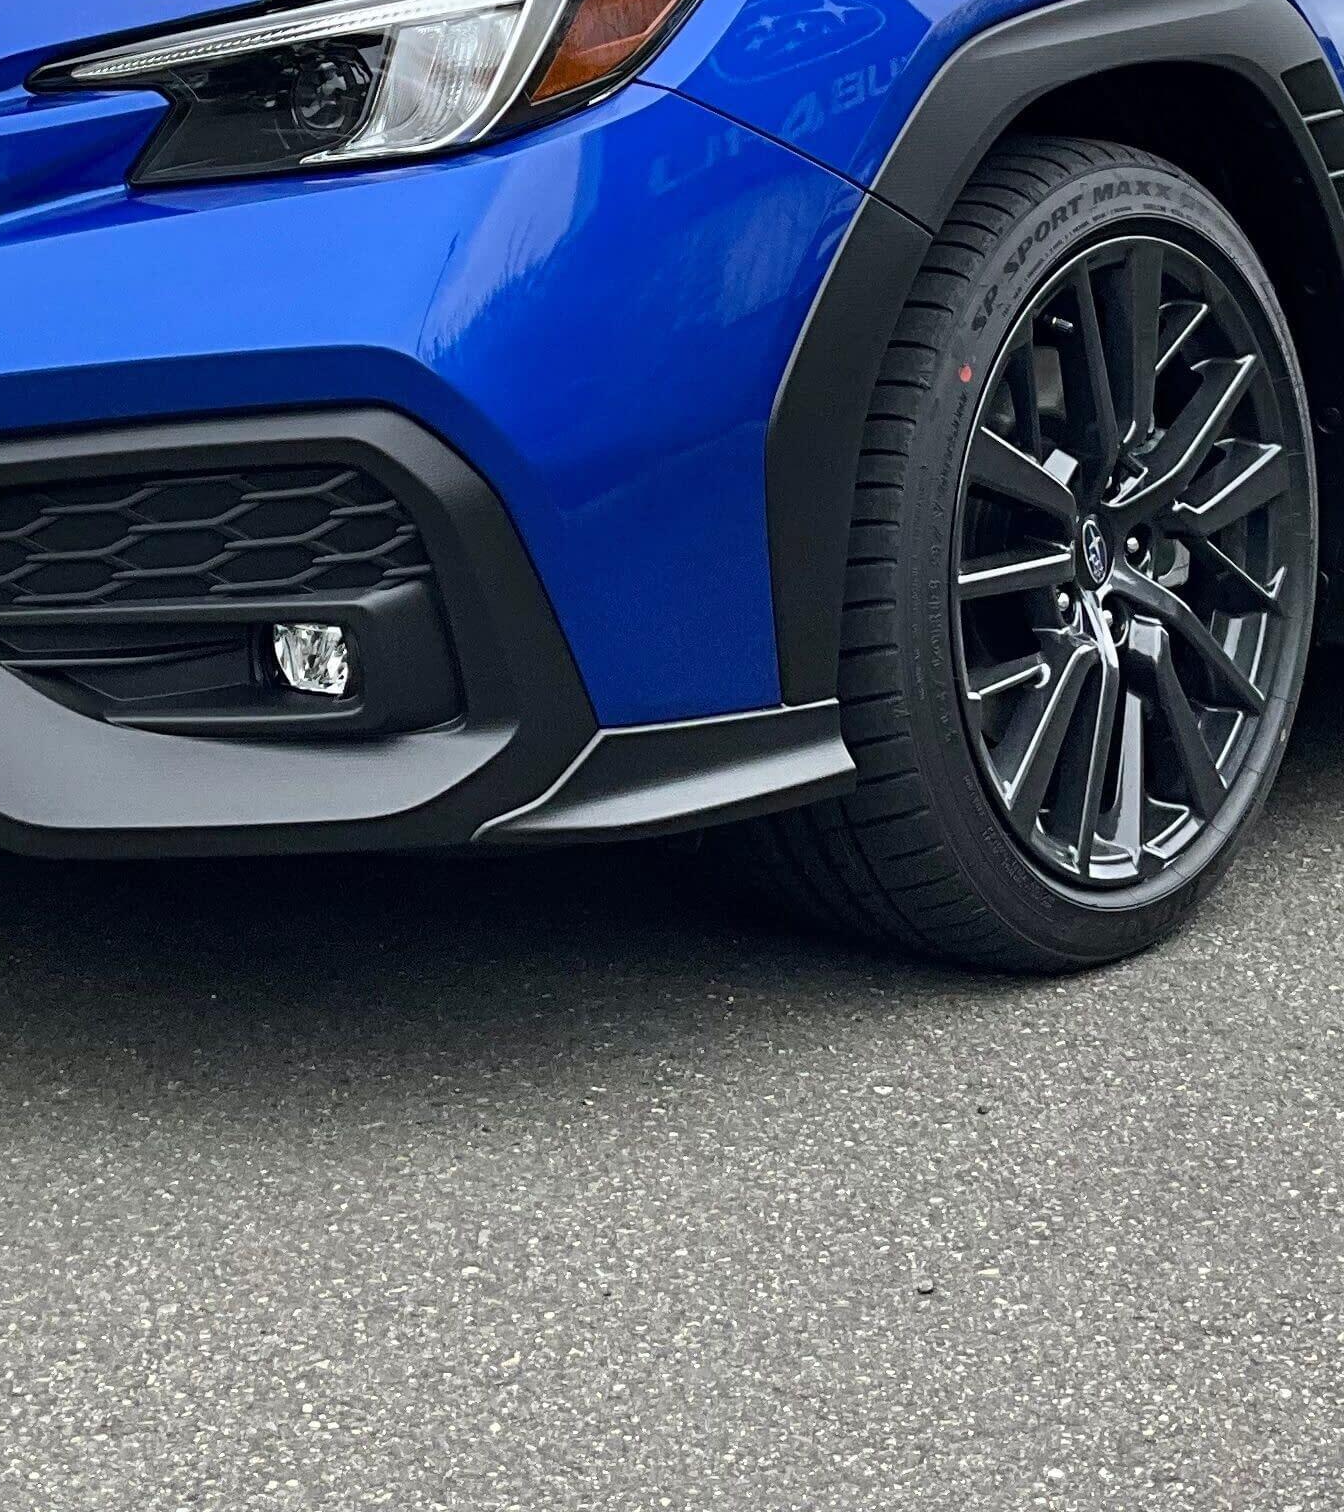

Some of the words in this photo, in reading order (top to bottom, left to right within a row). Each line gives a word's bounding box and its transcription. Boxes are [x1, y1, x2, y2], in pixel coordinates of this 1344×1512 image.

[971, 285, 998, 332] SP
[1004, 194, 1084, 275] SPORT
[1093, 180, 1173, 205] MAXX
